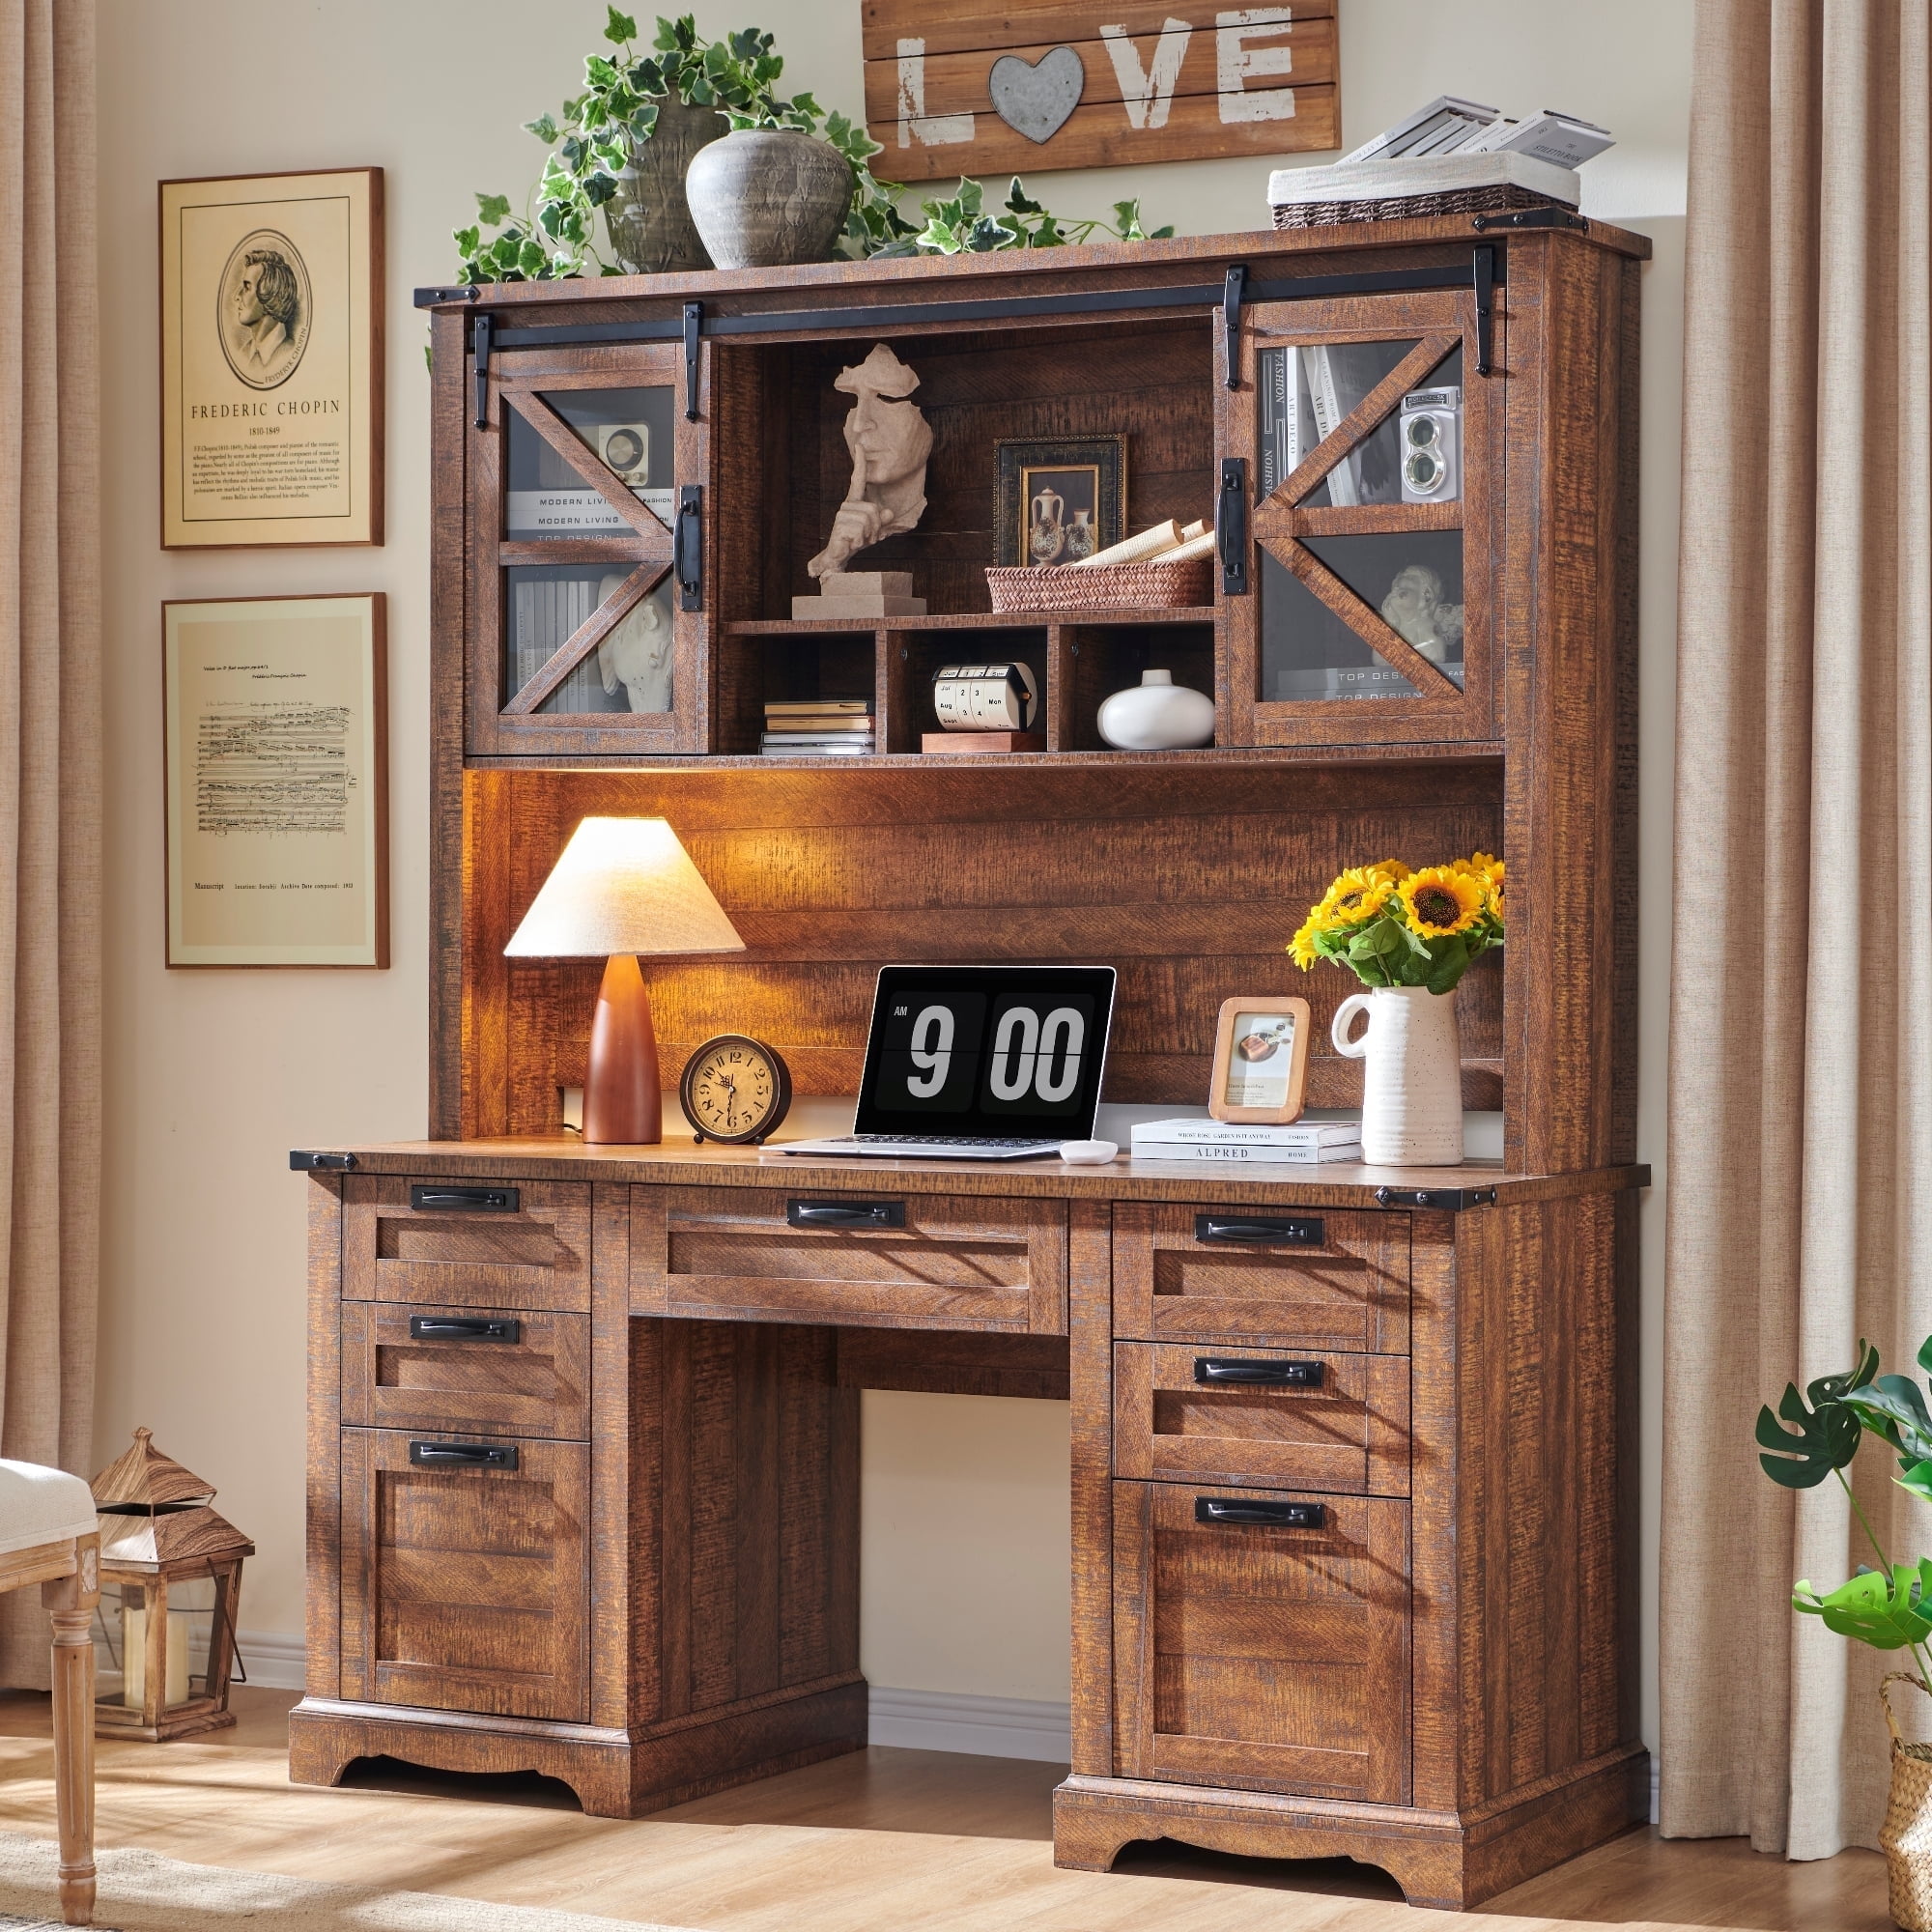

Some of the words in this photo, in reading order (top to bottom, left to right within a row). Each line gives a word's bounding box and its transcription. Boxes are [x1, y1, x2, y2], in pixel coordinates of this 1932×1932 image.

[1275, 354, 1284, 403] FASHION
[191, 403, 268, 418] FREDERIC
[277, 400, 339, 415] CHOPIN
[1315, 395, 1326, 417] ART
[1320, 418, 1329, 437] DE
[194, 882, 224, 891] Manuscript
[730, 1052, 742, 1063] 12
[894, 1006, 908, 1016] AM
[907, 1005, 955, 1098] 9
[990, 1007, 1085, 1102] 00
[716, 1056, 725, 1067] 11
[747, 1058, 753, 1066] 1
[703, 1066, 715, 1079] 10
[754, 1068, 766, 1080] 2
[699, 1084, 710, 1094] 9
[702, 1099, 714, 1111] 8
[713, 1109, 724, 1122] 7
[742, 1111, 752, 1123] 5
[1196, 1149, 1248, 1157] ALPRED
